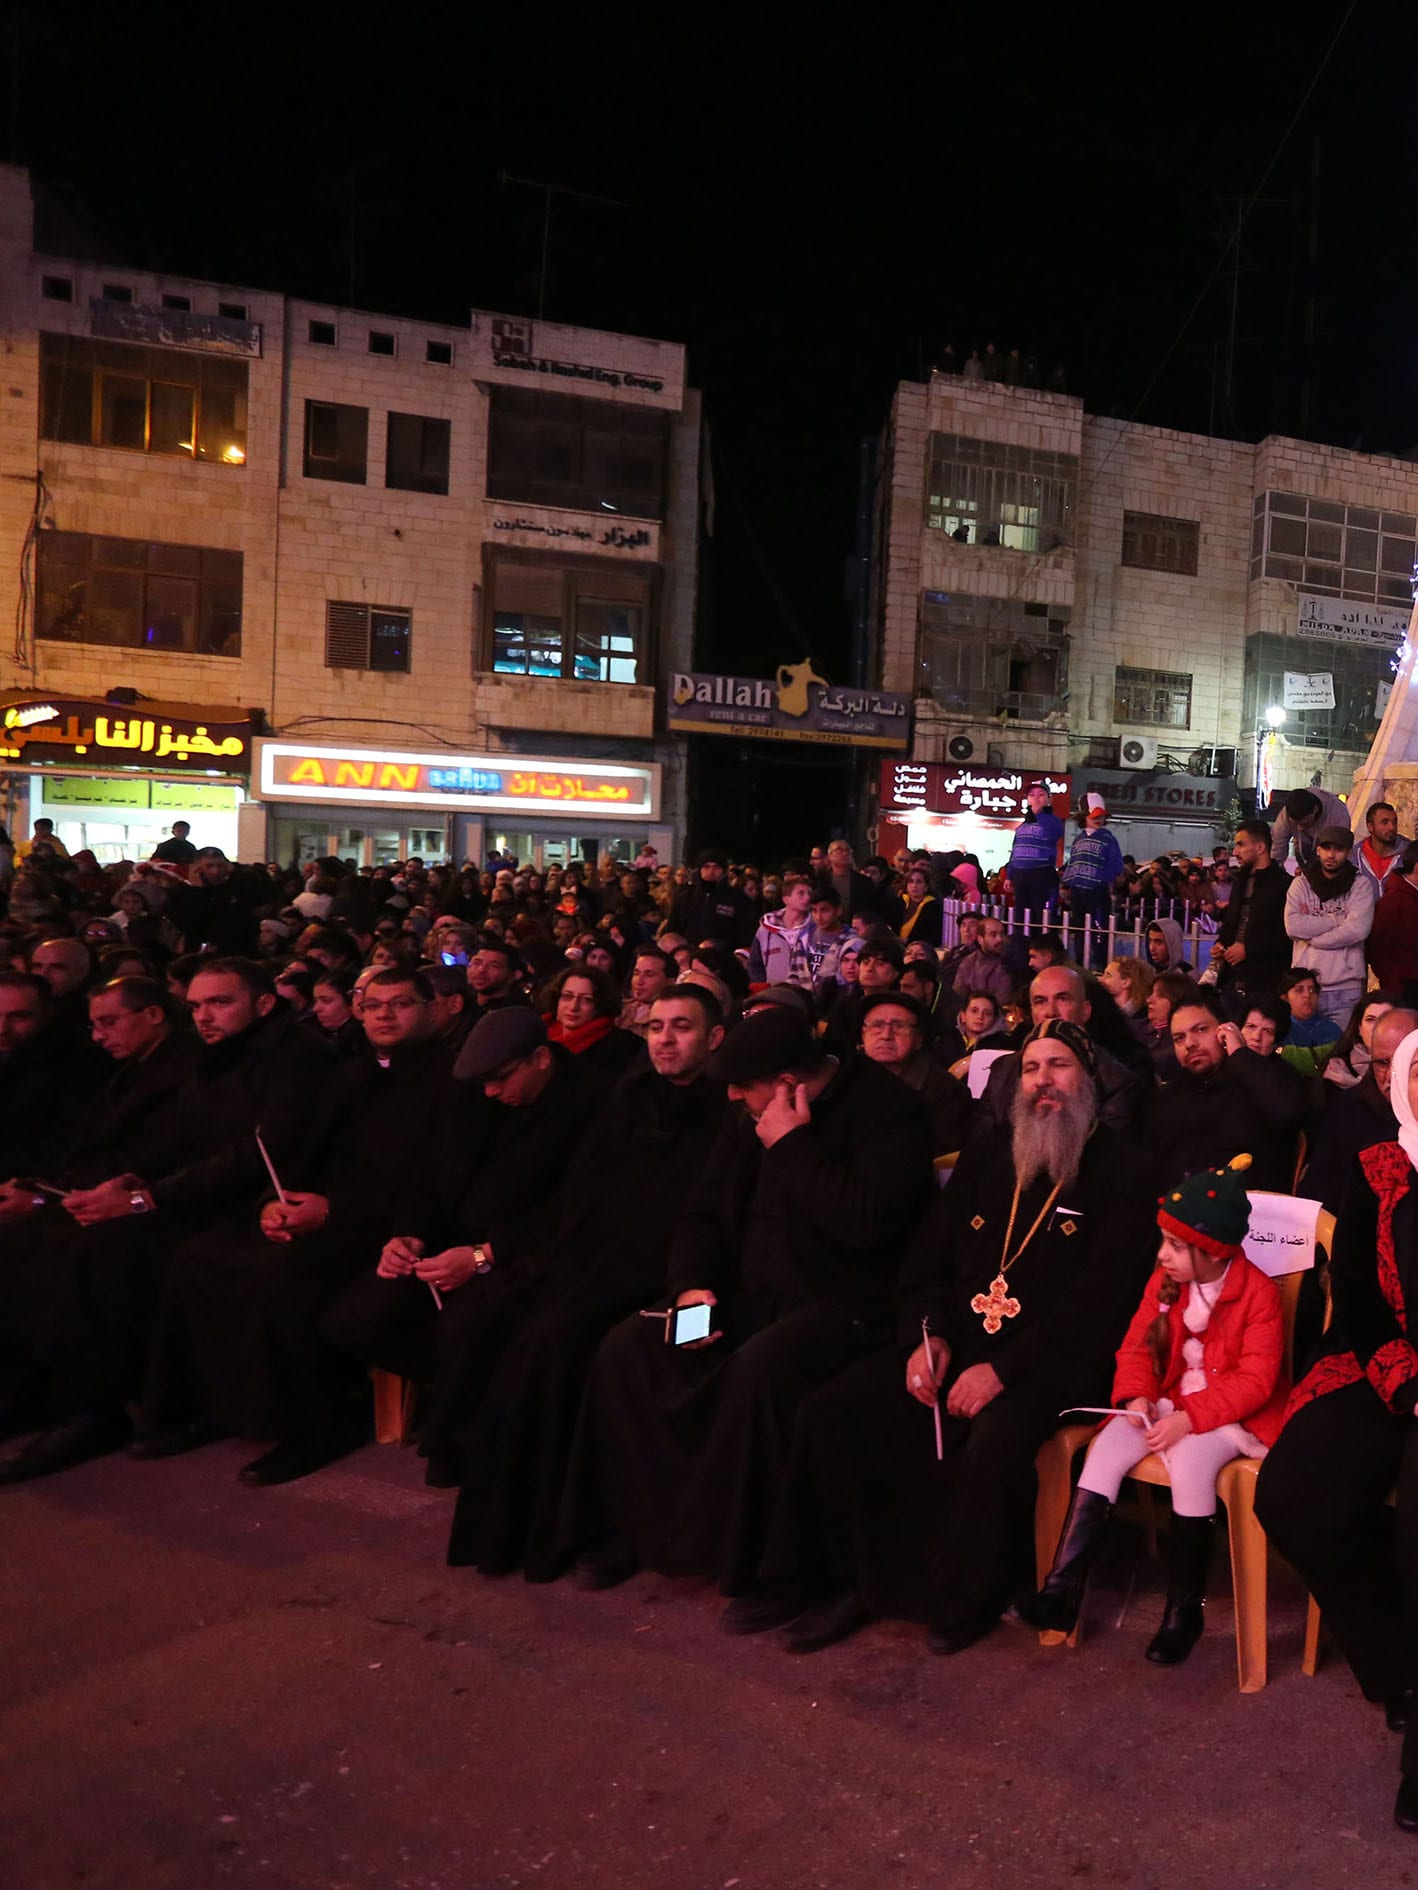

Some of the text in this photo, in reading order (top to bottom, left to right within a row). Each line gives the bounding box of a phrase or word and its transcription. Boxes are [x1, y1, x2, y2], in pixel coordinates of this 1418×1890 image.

[596, 369, 620, 387] Eng.
[623, 374, 663, 392] Group
[673, 674, 772, 708] Dallah
[818, 690, 870, 716] البركة
[710, 710, 738, 720] rent
[749, 713, 768, 723] car
[0, 715, 244, 760] مخبز النابلسي
[288, 758, 420, 791] ANN
[895, 764, 927, 774] حمص
[895, 774, 927, 783] فول
[539, 774, 632, 801] محلات
[893, 784, 926, 794] فلافل
[944, 769, 1022, 793] الحمصاني
[960, 789, 1017, 813] جبارة
[1143, 786, 1216, 807] STORES
[1249, 1228, 1276, 1246] اللجنة
